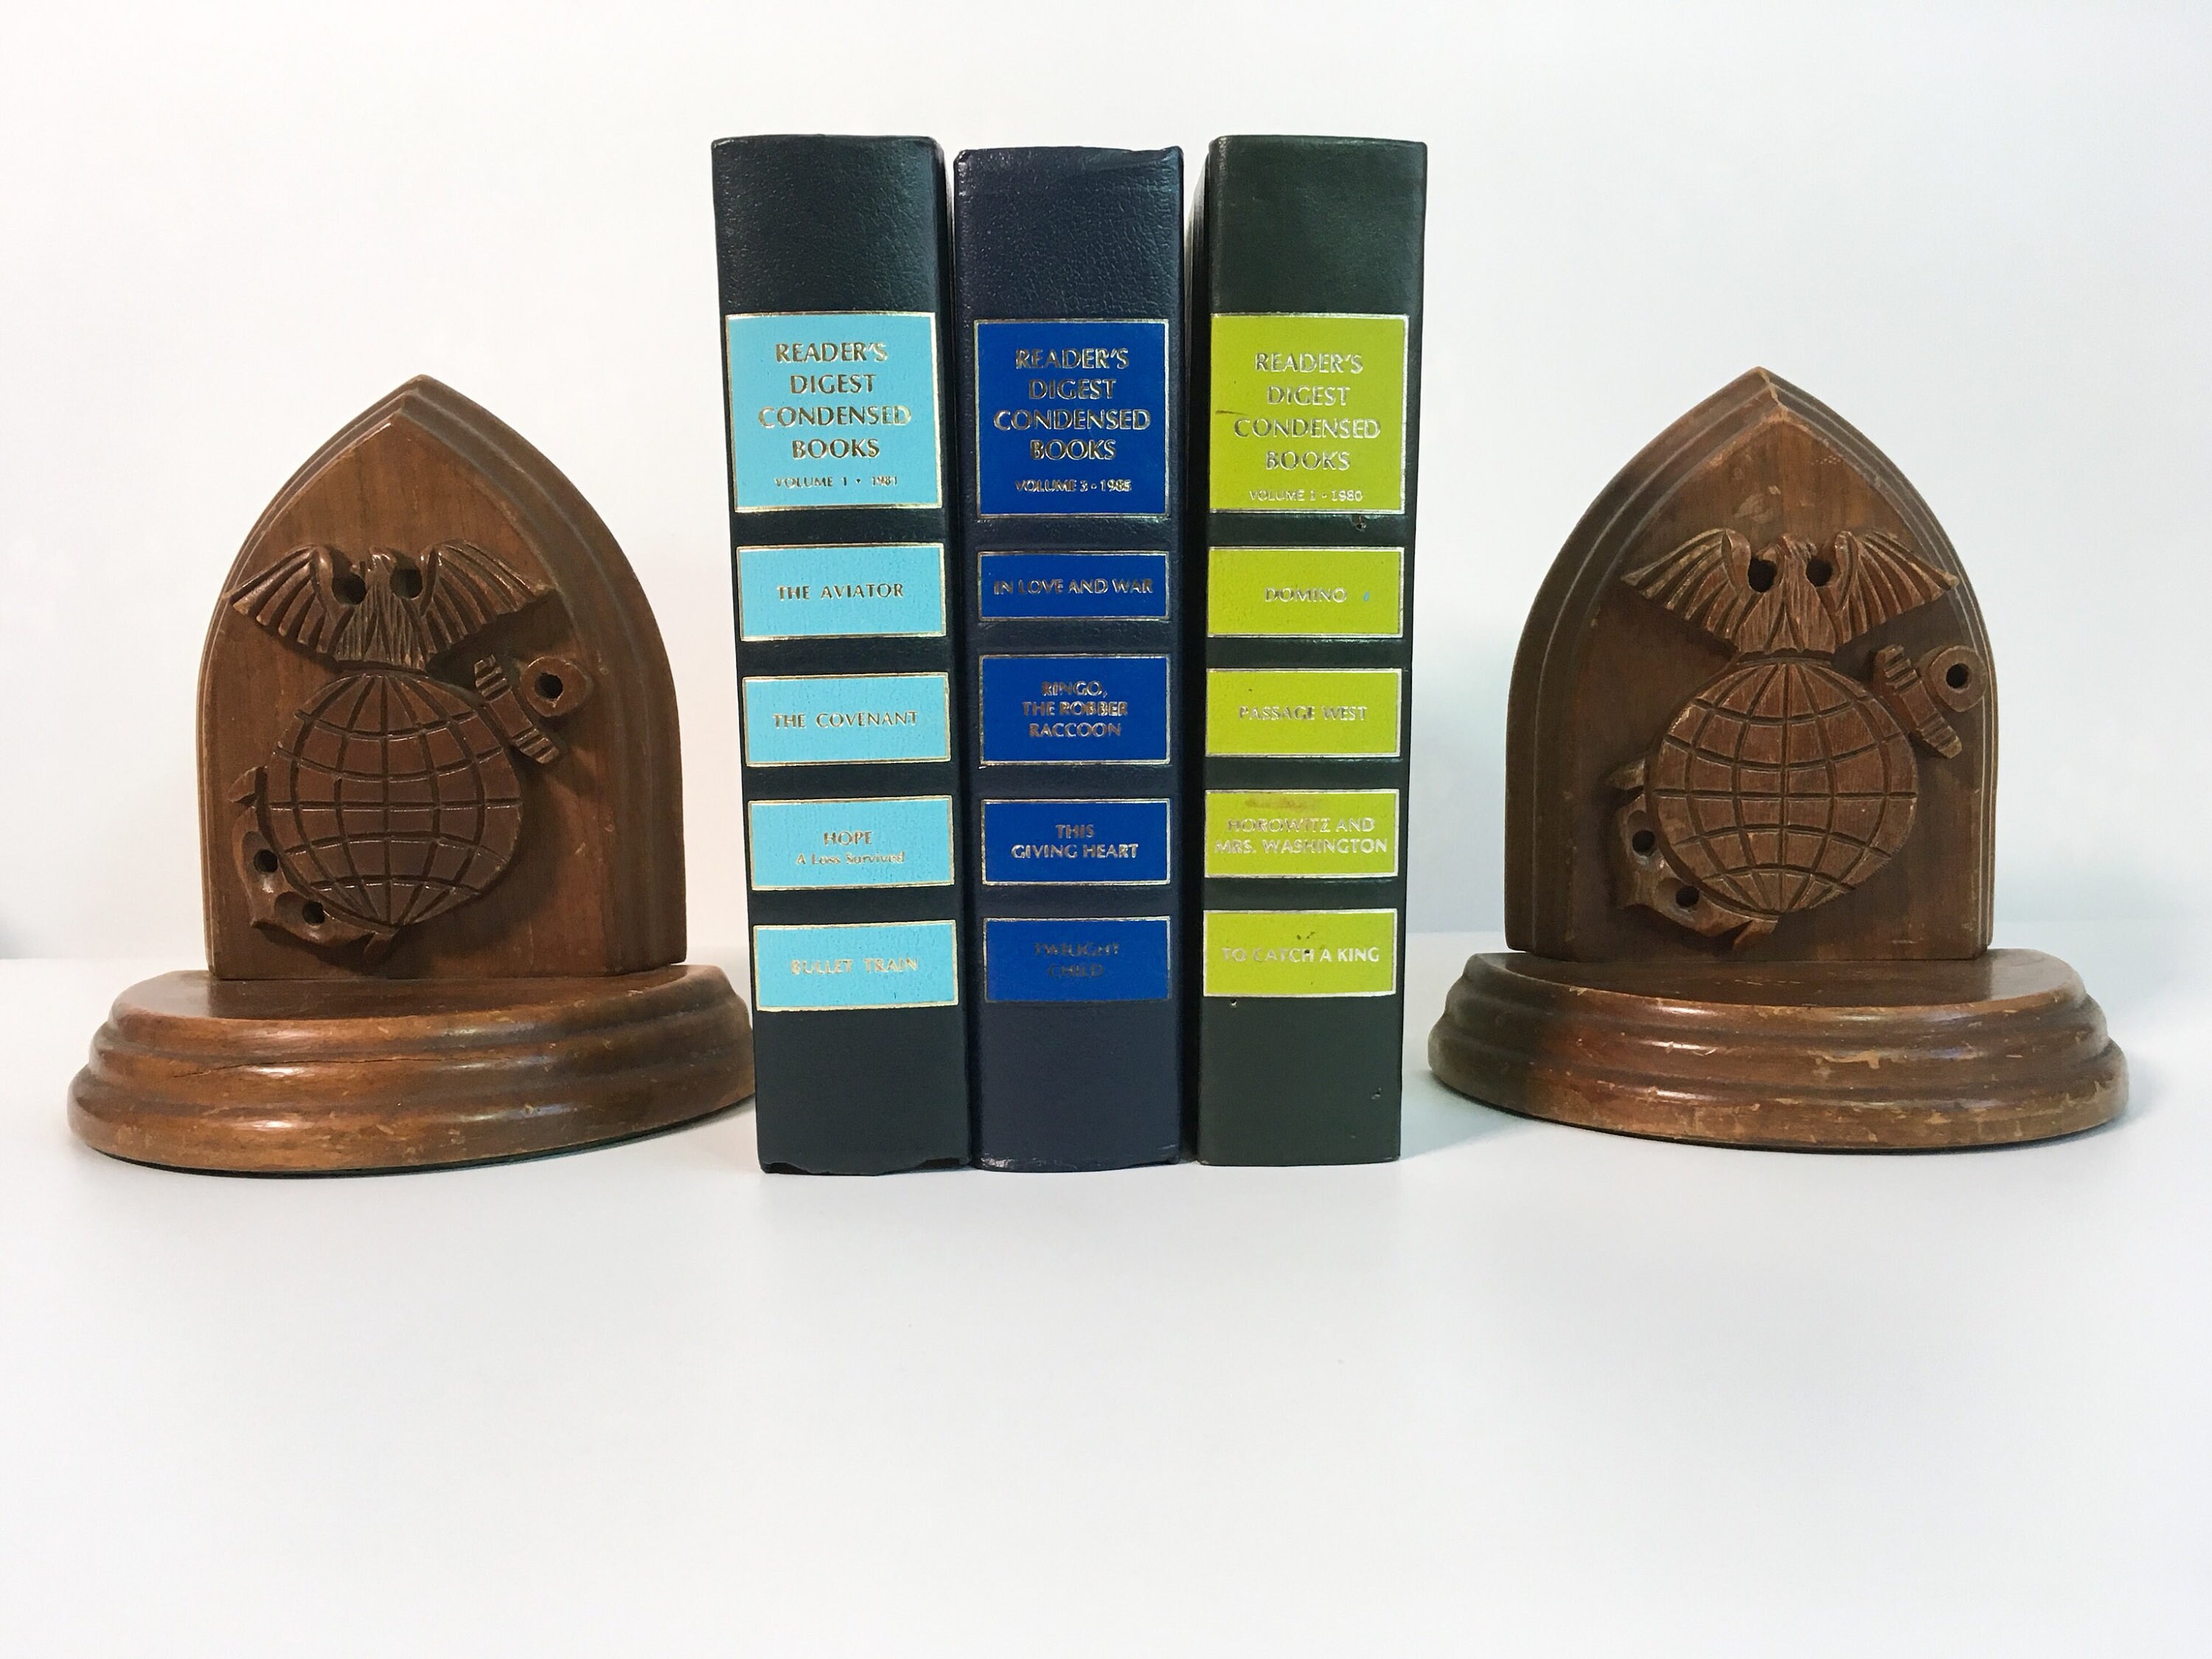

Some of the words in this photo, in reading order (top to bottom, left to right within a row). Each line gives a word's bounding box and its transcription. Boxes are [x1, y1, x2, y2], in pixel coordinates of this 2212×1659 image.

[776, 342, 888, 363] READER'S
[1016, 348, 1129, 369] READER'S
[1255, 352, 1363, 374] READER'S
[790, 374, 876, 394] DIGEST
[1029, 379, 1116, 400] DIGEST
[1267, 386, 1351, 406] DIGEST
[757, 406, 912, 428] CONDENSED
[993, 409, 1150, 431] CONDENSED
[1234, 418, 1380, 438] CONDENSED
[792, 439, 880, 459] BOOKS
[1030, 439, 1116, 460] BOOKS
[1265, 451, 1351, 470] BOOKS
[776, 477, 833, 488] VOLUME
[872, 476, 898, 486] 1981
[1015, 479, 1077, 492] VOLUME
[1079, 480, 1088, 491] 3
[1249, 490, 1305, 501] VOLUME
[776, 585, 810, 601] THE
[821, 583, 905, 600] AVIATOR
[994, 580, 1013, 594] IN
[1018, 580, 1063, 594] LOVE
[1068, 579, 1107, 594] AND
[1112, 578, 1153, 593] WAR
[1265, 588, 1347, 603] DOMINO
[1022, 702, 1055, 717] THE
[1060, 701, 1128, 717] ROBBER
[1239, 706, 1315, 721] PASSAGE
[1321, 706, 1367, 721] WEST
[773, 713, 806, 729] THE
[815, 710, 919, 728] COVENANT
[1029, 723, 1121, 737] RACCOON
[1056, 824, 1094, 838] THIS
[1227, 818, 1330, 832] HOROWITZ
[1335, 818, 1374, 832] AND
[824, 831, 873, 846] HOPE
[1262, 838, 1388, 854] WASHINGTON
[795, 854, 806, 865] A
[812, 853, 841, 865] Loss
[846, 850, 905, 865] Survived
[1011, 844, 1078, 858] GIVING
[1082, 844, 1138, 858] HEART
[1221, 947, 1246, 963] TO
[1253, 947, 1314, 963] CATCH
[1320, 948, 1332, 962] A
[1338, 947, 1380, 962] KING
[790, 959, 853, 975] BULLET
[864, 957, 918, 973] TRAIN
